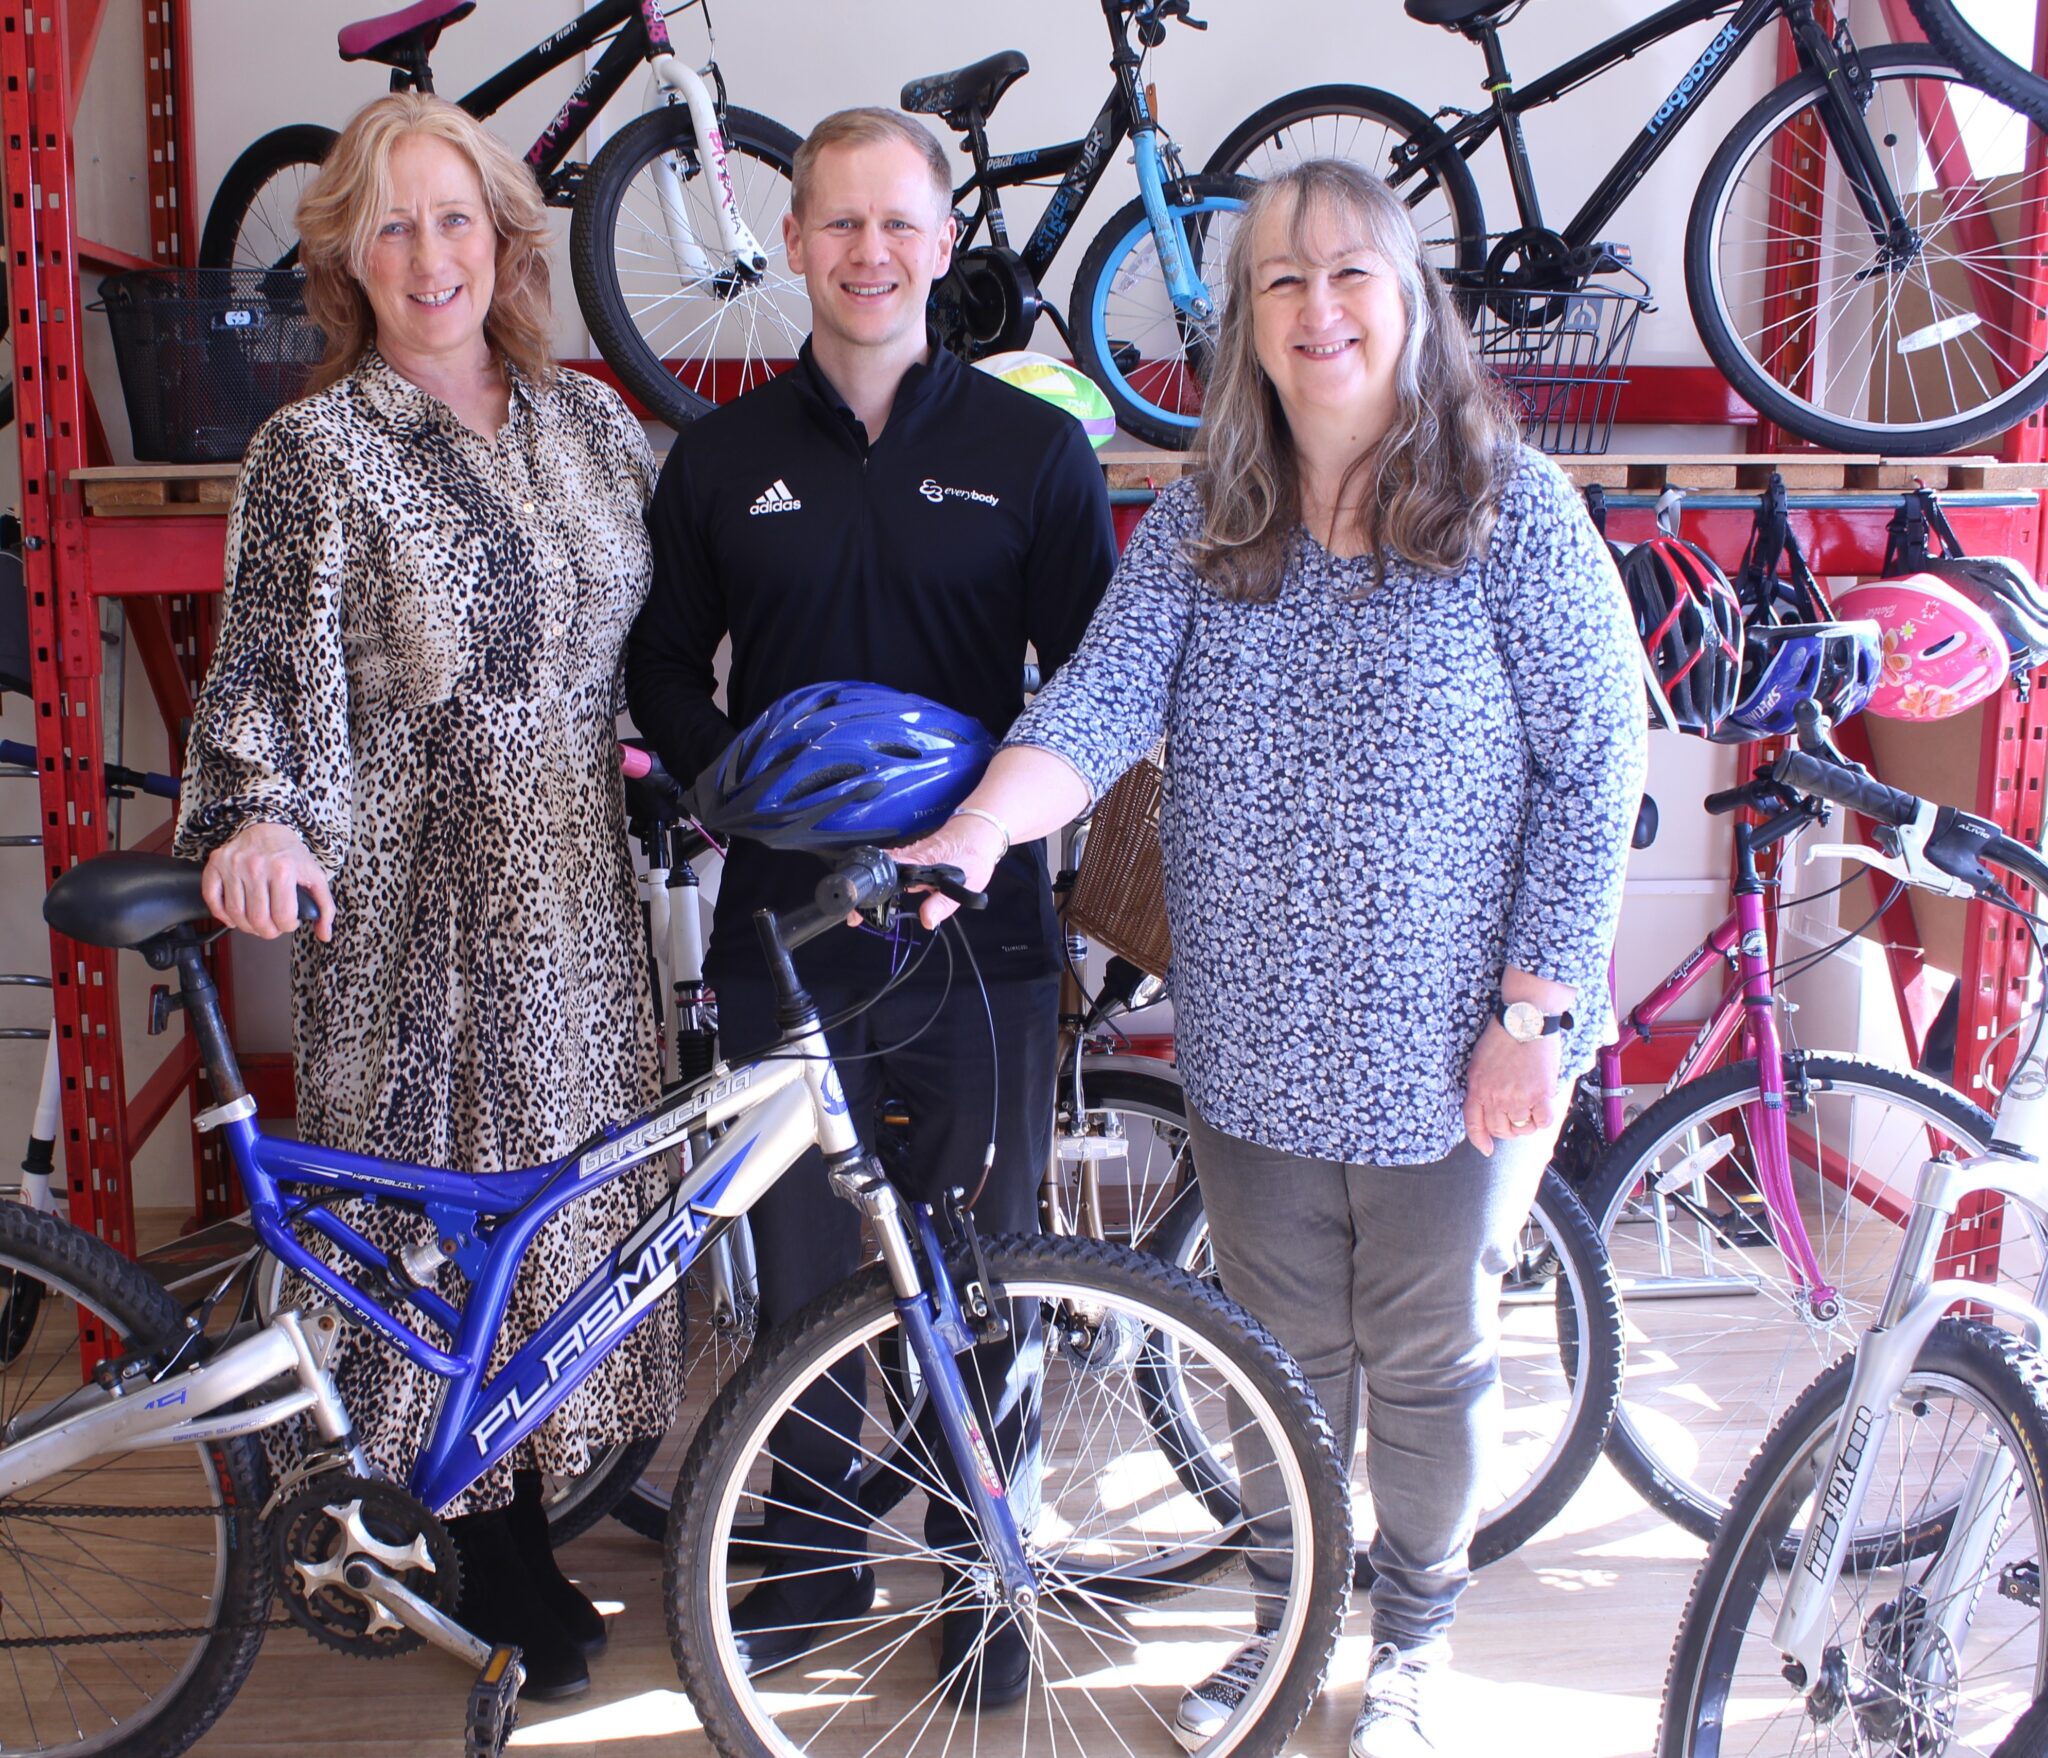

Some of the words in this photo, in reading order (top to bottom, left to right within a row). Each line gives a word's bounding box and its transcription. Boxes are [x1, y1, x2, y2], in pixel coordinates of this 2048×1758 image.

[538, 38, 553, 55] fly
[555, 20, 578, 43] fish
[750, 499, 802, 516] adidas
[944, 486, 1000, 507] everybody
[1957, 823, 1991, 840] ALIVIO
[301, 1266, 354, 1309] DESIGNED
[354, 1307, 371, 1321] IN
[471, 1206, 696, 1457] PLASMA
